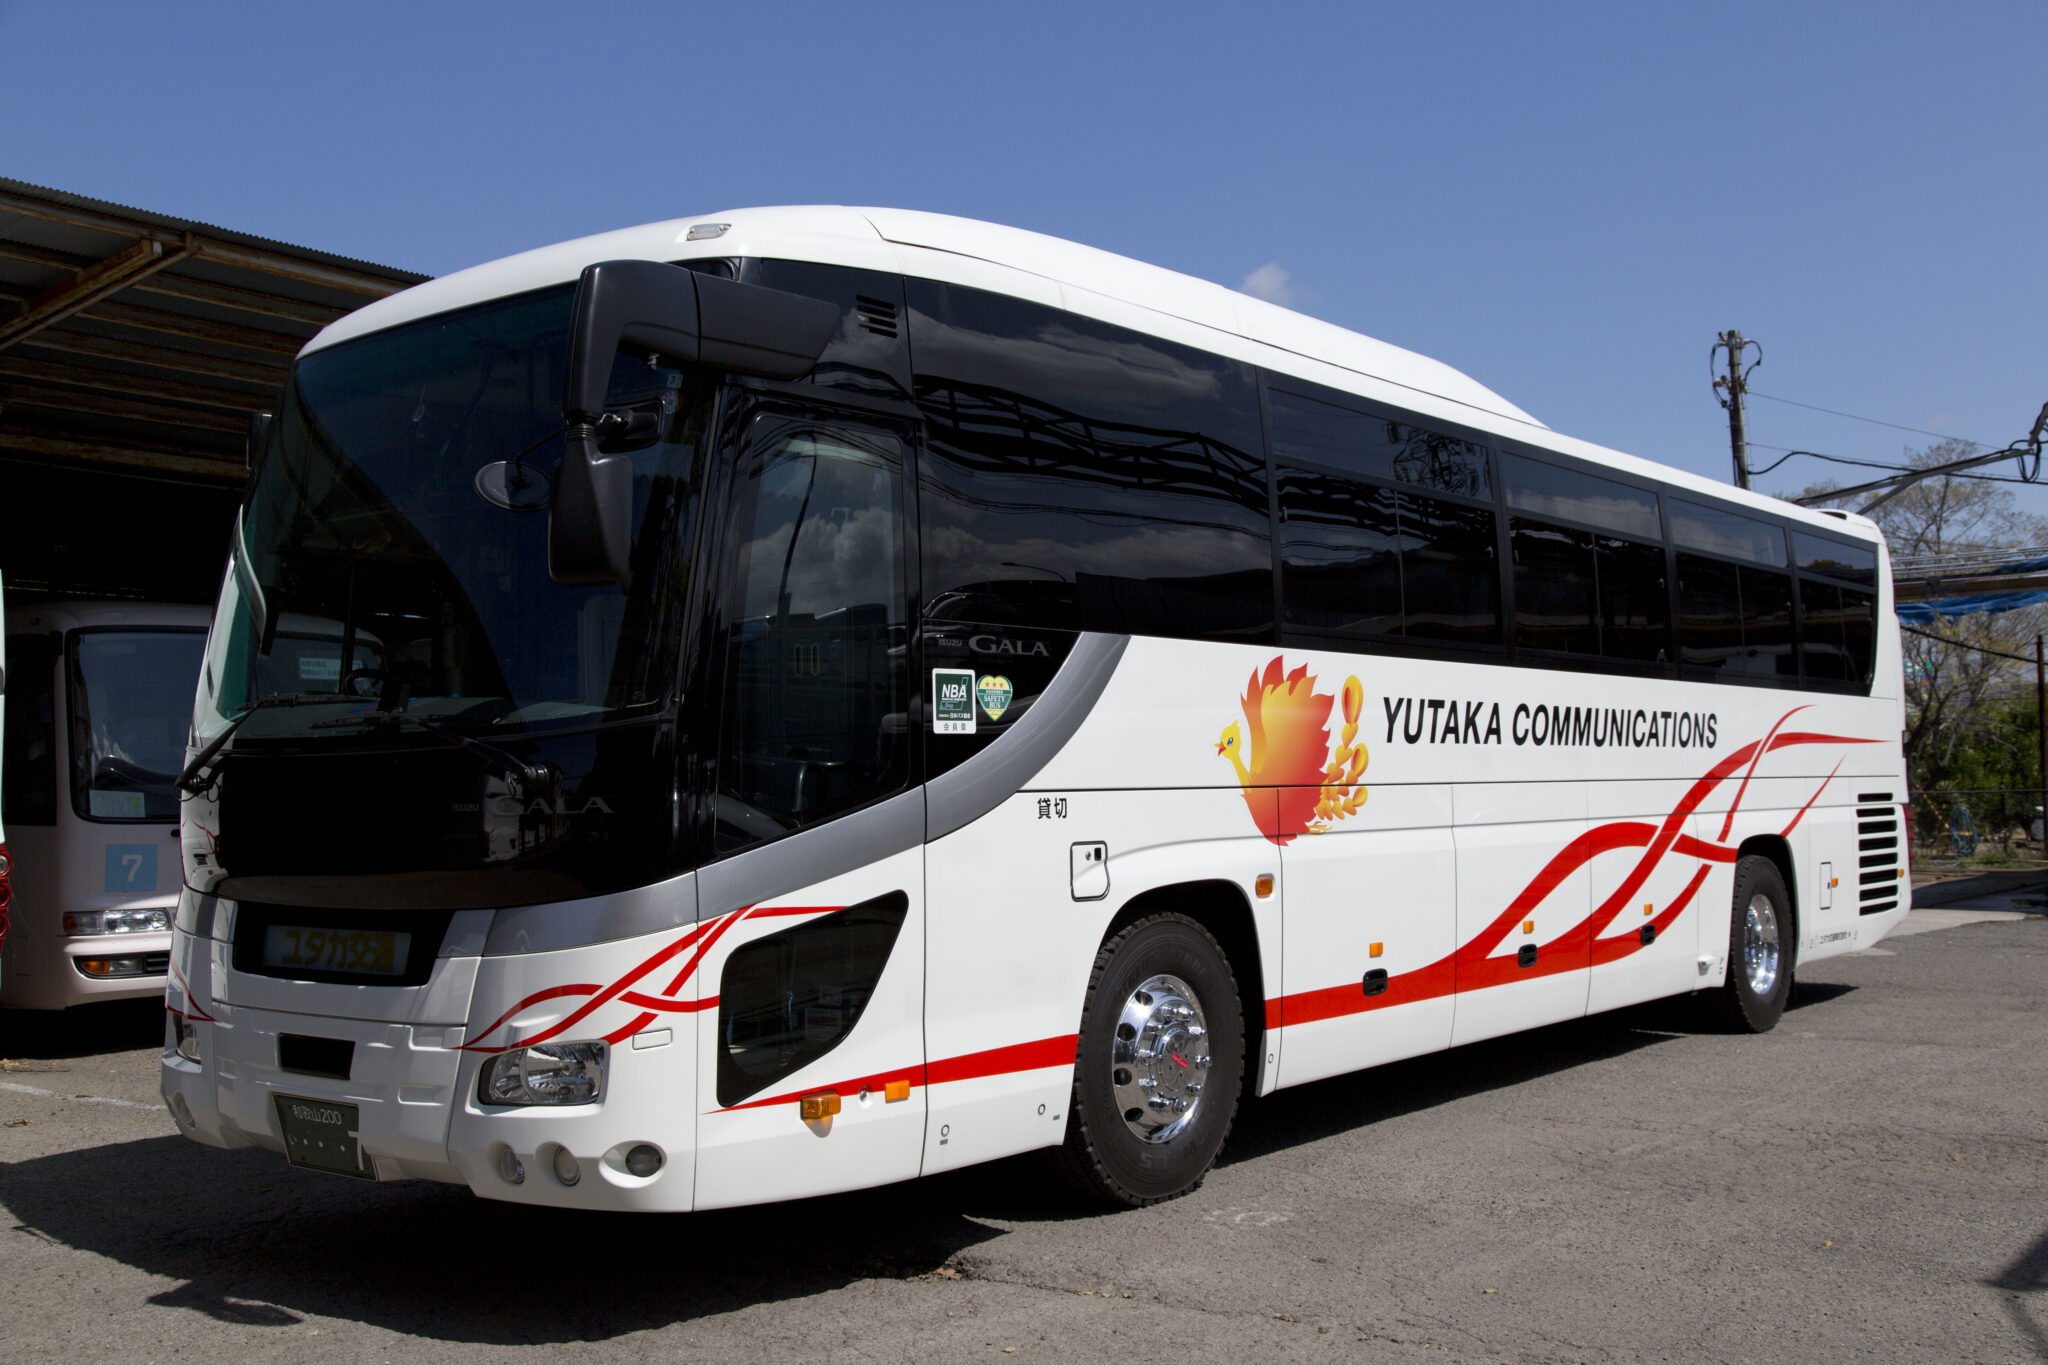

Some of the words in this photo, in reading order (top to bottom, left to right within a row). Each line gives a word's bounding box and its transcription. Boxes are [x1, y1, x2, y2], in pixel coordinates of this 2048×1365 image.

[938, 638, 962, 647] ISUZU
[968, 634, 1050, 657] GALA
[941, 683, 967, 698] NBA
[983, 694, 1006, 703] SAFETY
[989, 701, 1001, 709] BUS
[1383, 697, 1502, 745] YUTAKA
[1512, 703, 1718, 749] COMMUNICATIONS
[1037, 797, 1068, 819] 貸切
[121, 854, 142, 882] 7
[282, 929, 396, 973] ユタカ交通
